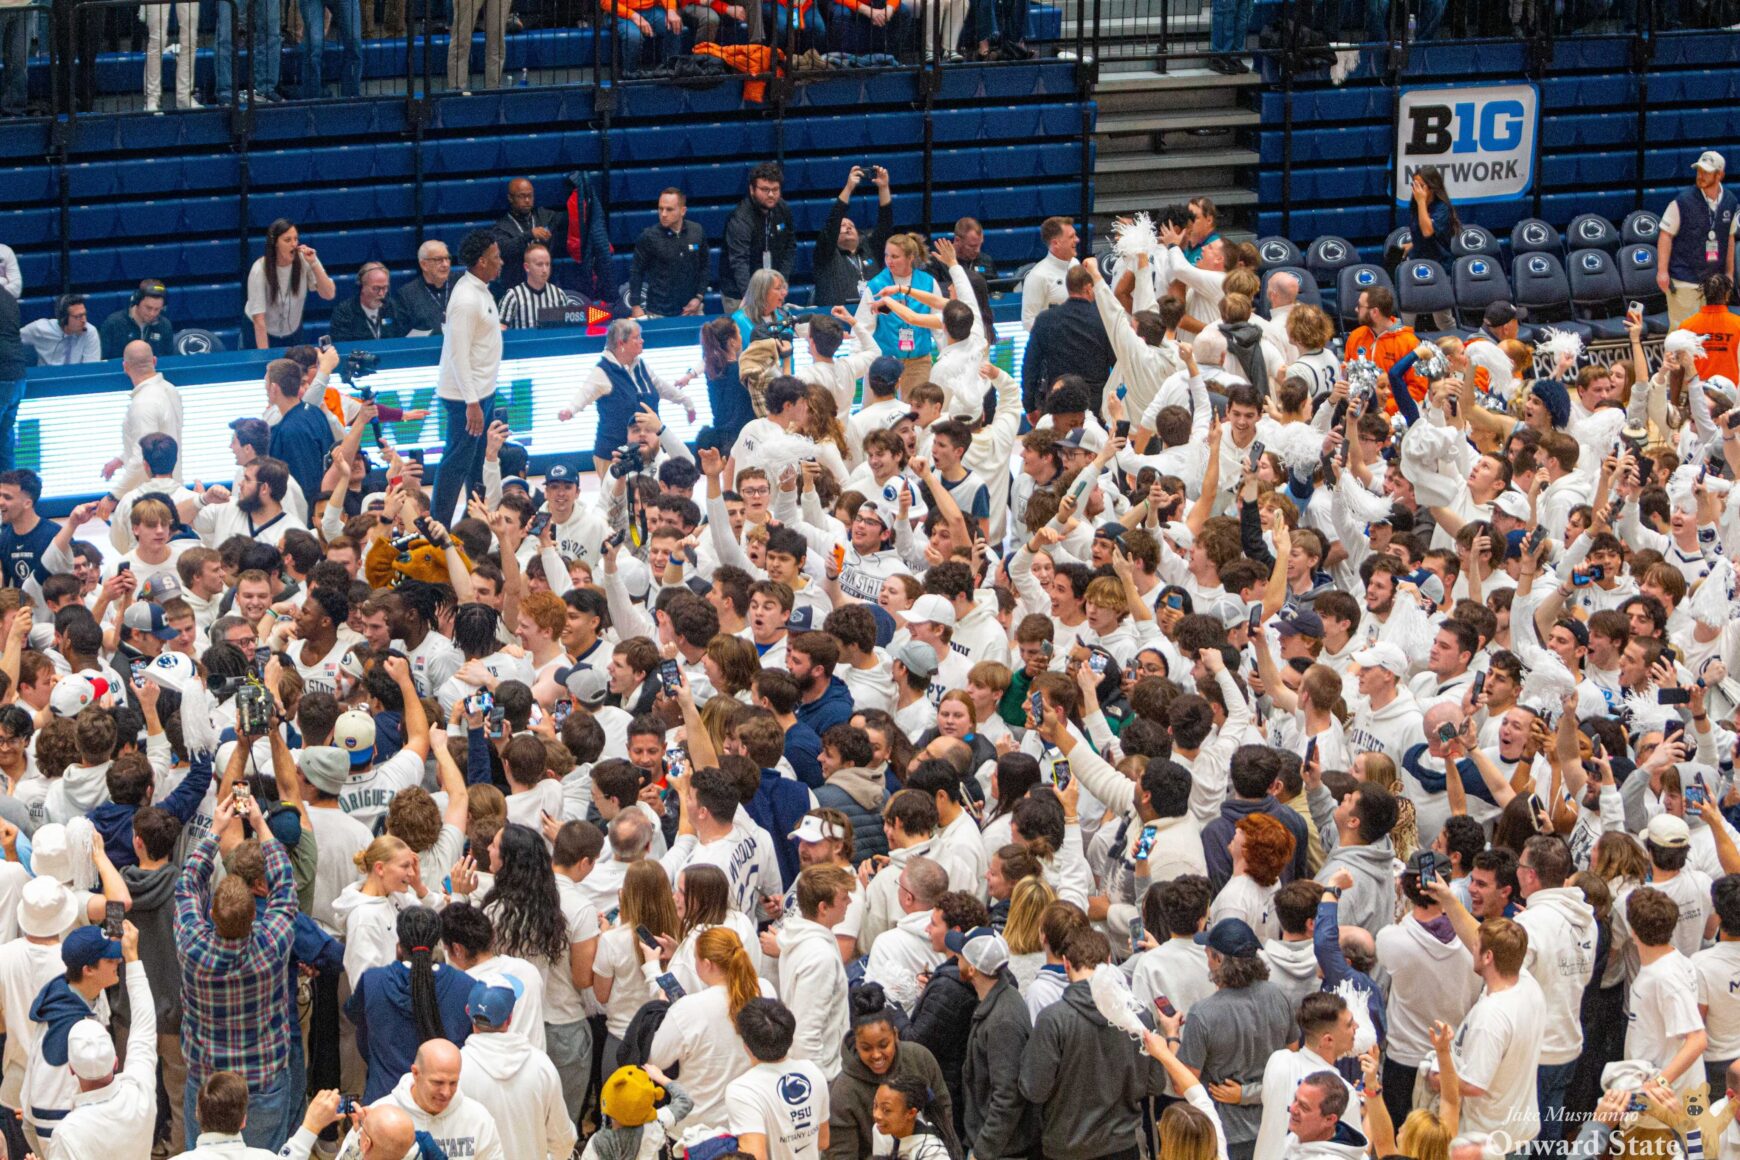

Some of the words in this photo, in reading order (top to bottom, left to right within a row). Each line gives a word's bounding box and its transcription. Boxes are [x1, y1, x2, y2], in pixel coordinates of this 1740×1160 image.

[1404, 159, 1519, 185] NTWORK
[855, 572, 880, 597] STAT
[190, 812, 214, 829] 202
[789, 1106, 812, 1122] PSU
